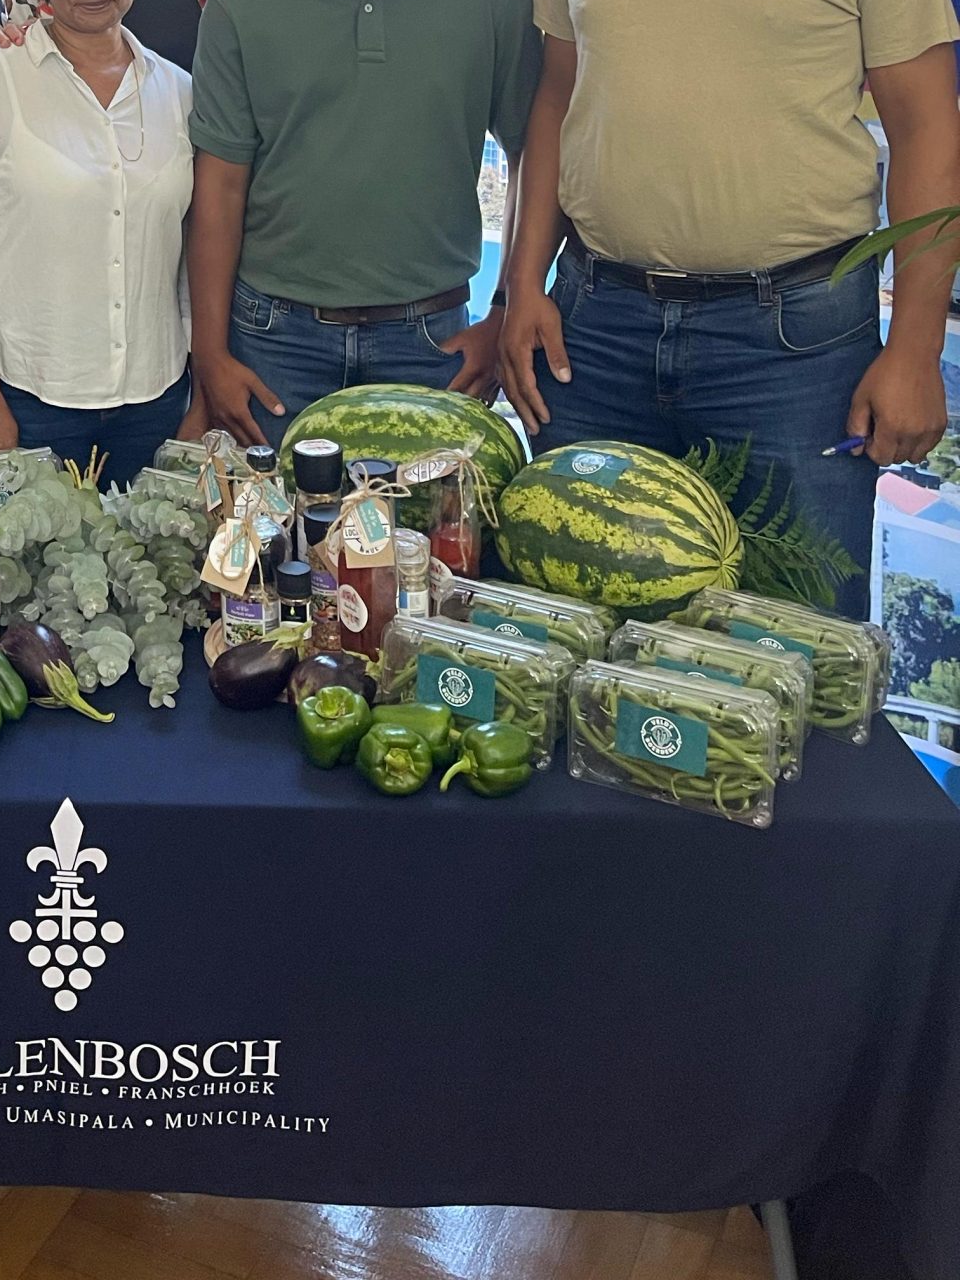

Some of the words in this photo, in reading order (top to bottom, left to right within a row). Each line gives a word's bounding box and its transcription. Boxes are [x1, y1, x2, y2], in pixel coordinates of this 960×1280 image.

[446, 669, 466, 680] VELDT
[650, 718, 674, 730] VELDT
[33, 1079, 93, 1096] PNIEL
[118, 1081, 275, 1100] FRANSCHHOEK
[5, 1106, 134, 1129] UMASIPALA
[165, 1110, 330, 1133] MUNICIPALITY
